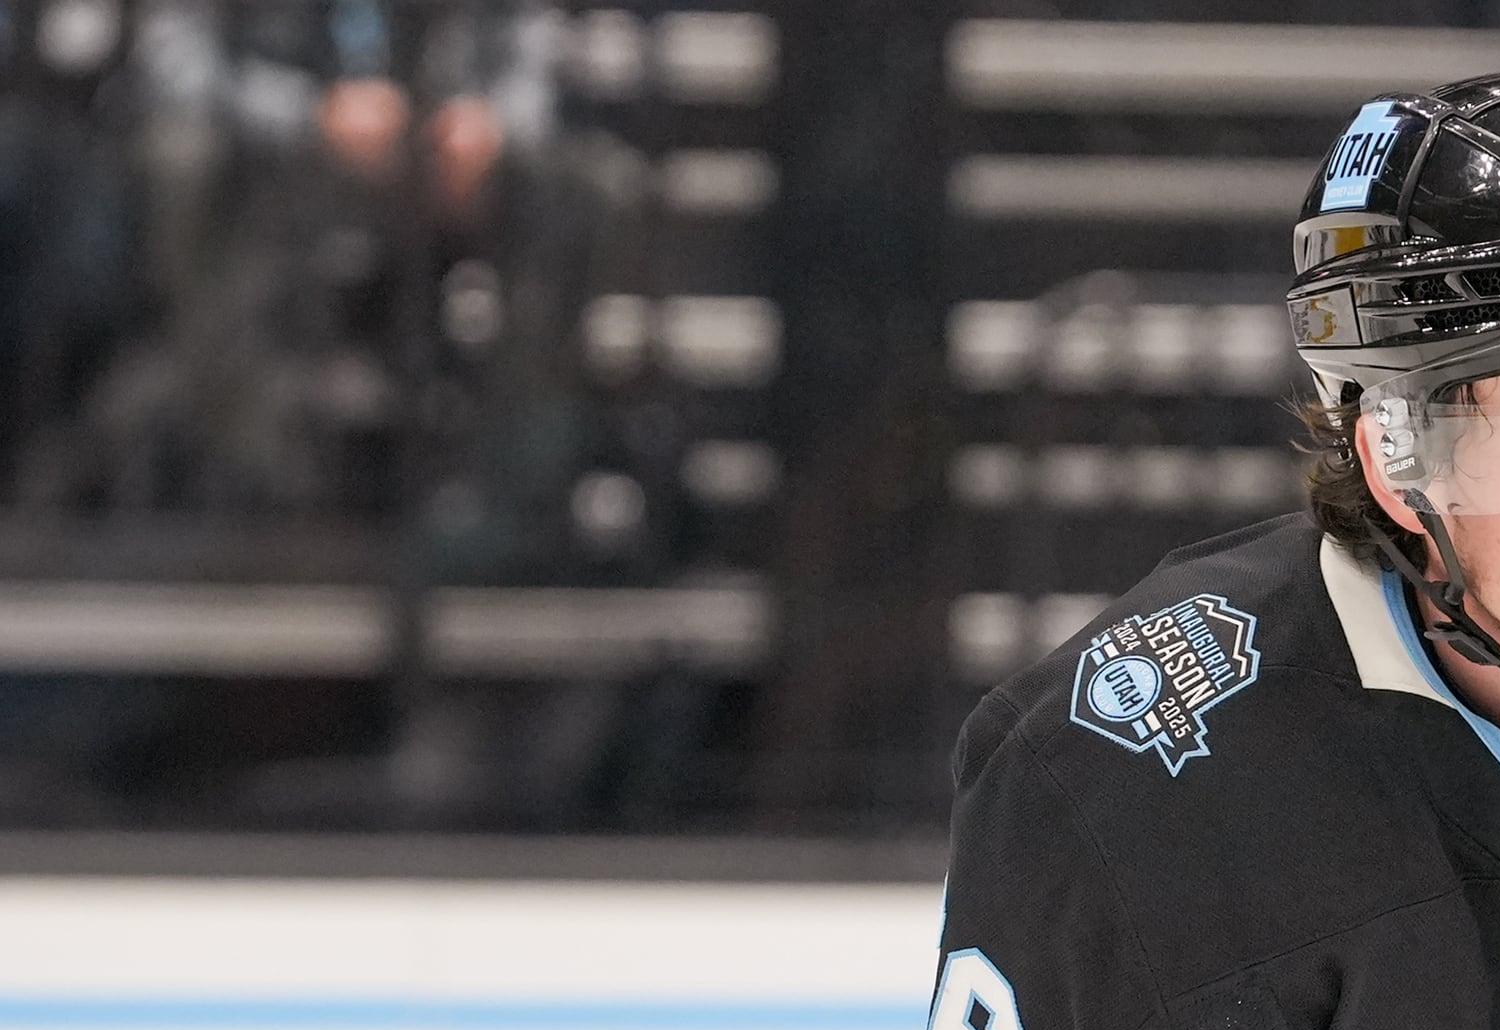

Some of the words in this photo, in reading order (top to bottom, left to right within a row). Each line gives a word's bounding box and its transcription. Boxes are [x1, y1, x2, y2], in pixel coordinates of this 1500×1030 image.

[1326, 132, 1397, 182] UTAH
[1113, 623, 1142, 653] 2024
[1141, 615, 1216, 710] SEASON
[1172, 603, 1235, 690] INAUGURAL
[1104, 664, 1144, 712] UTAH
[1158, 696, 1192, 739] 2025
